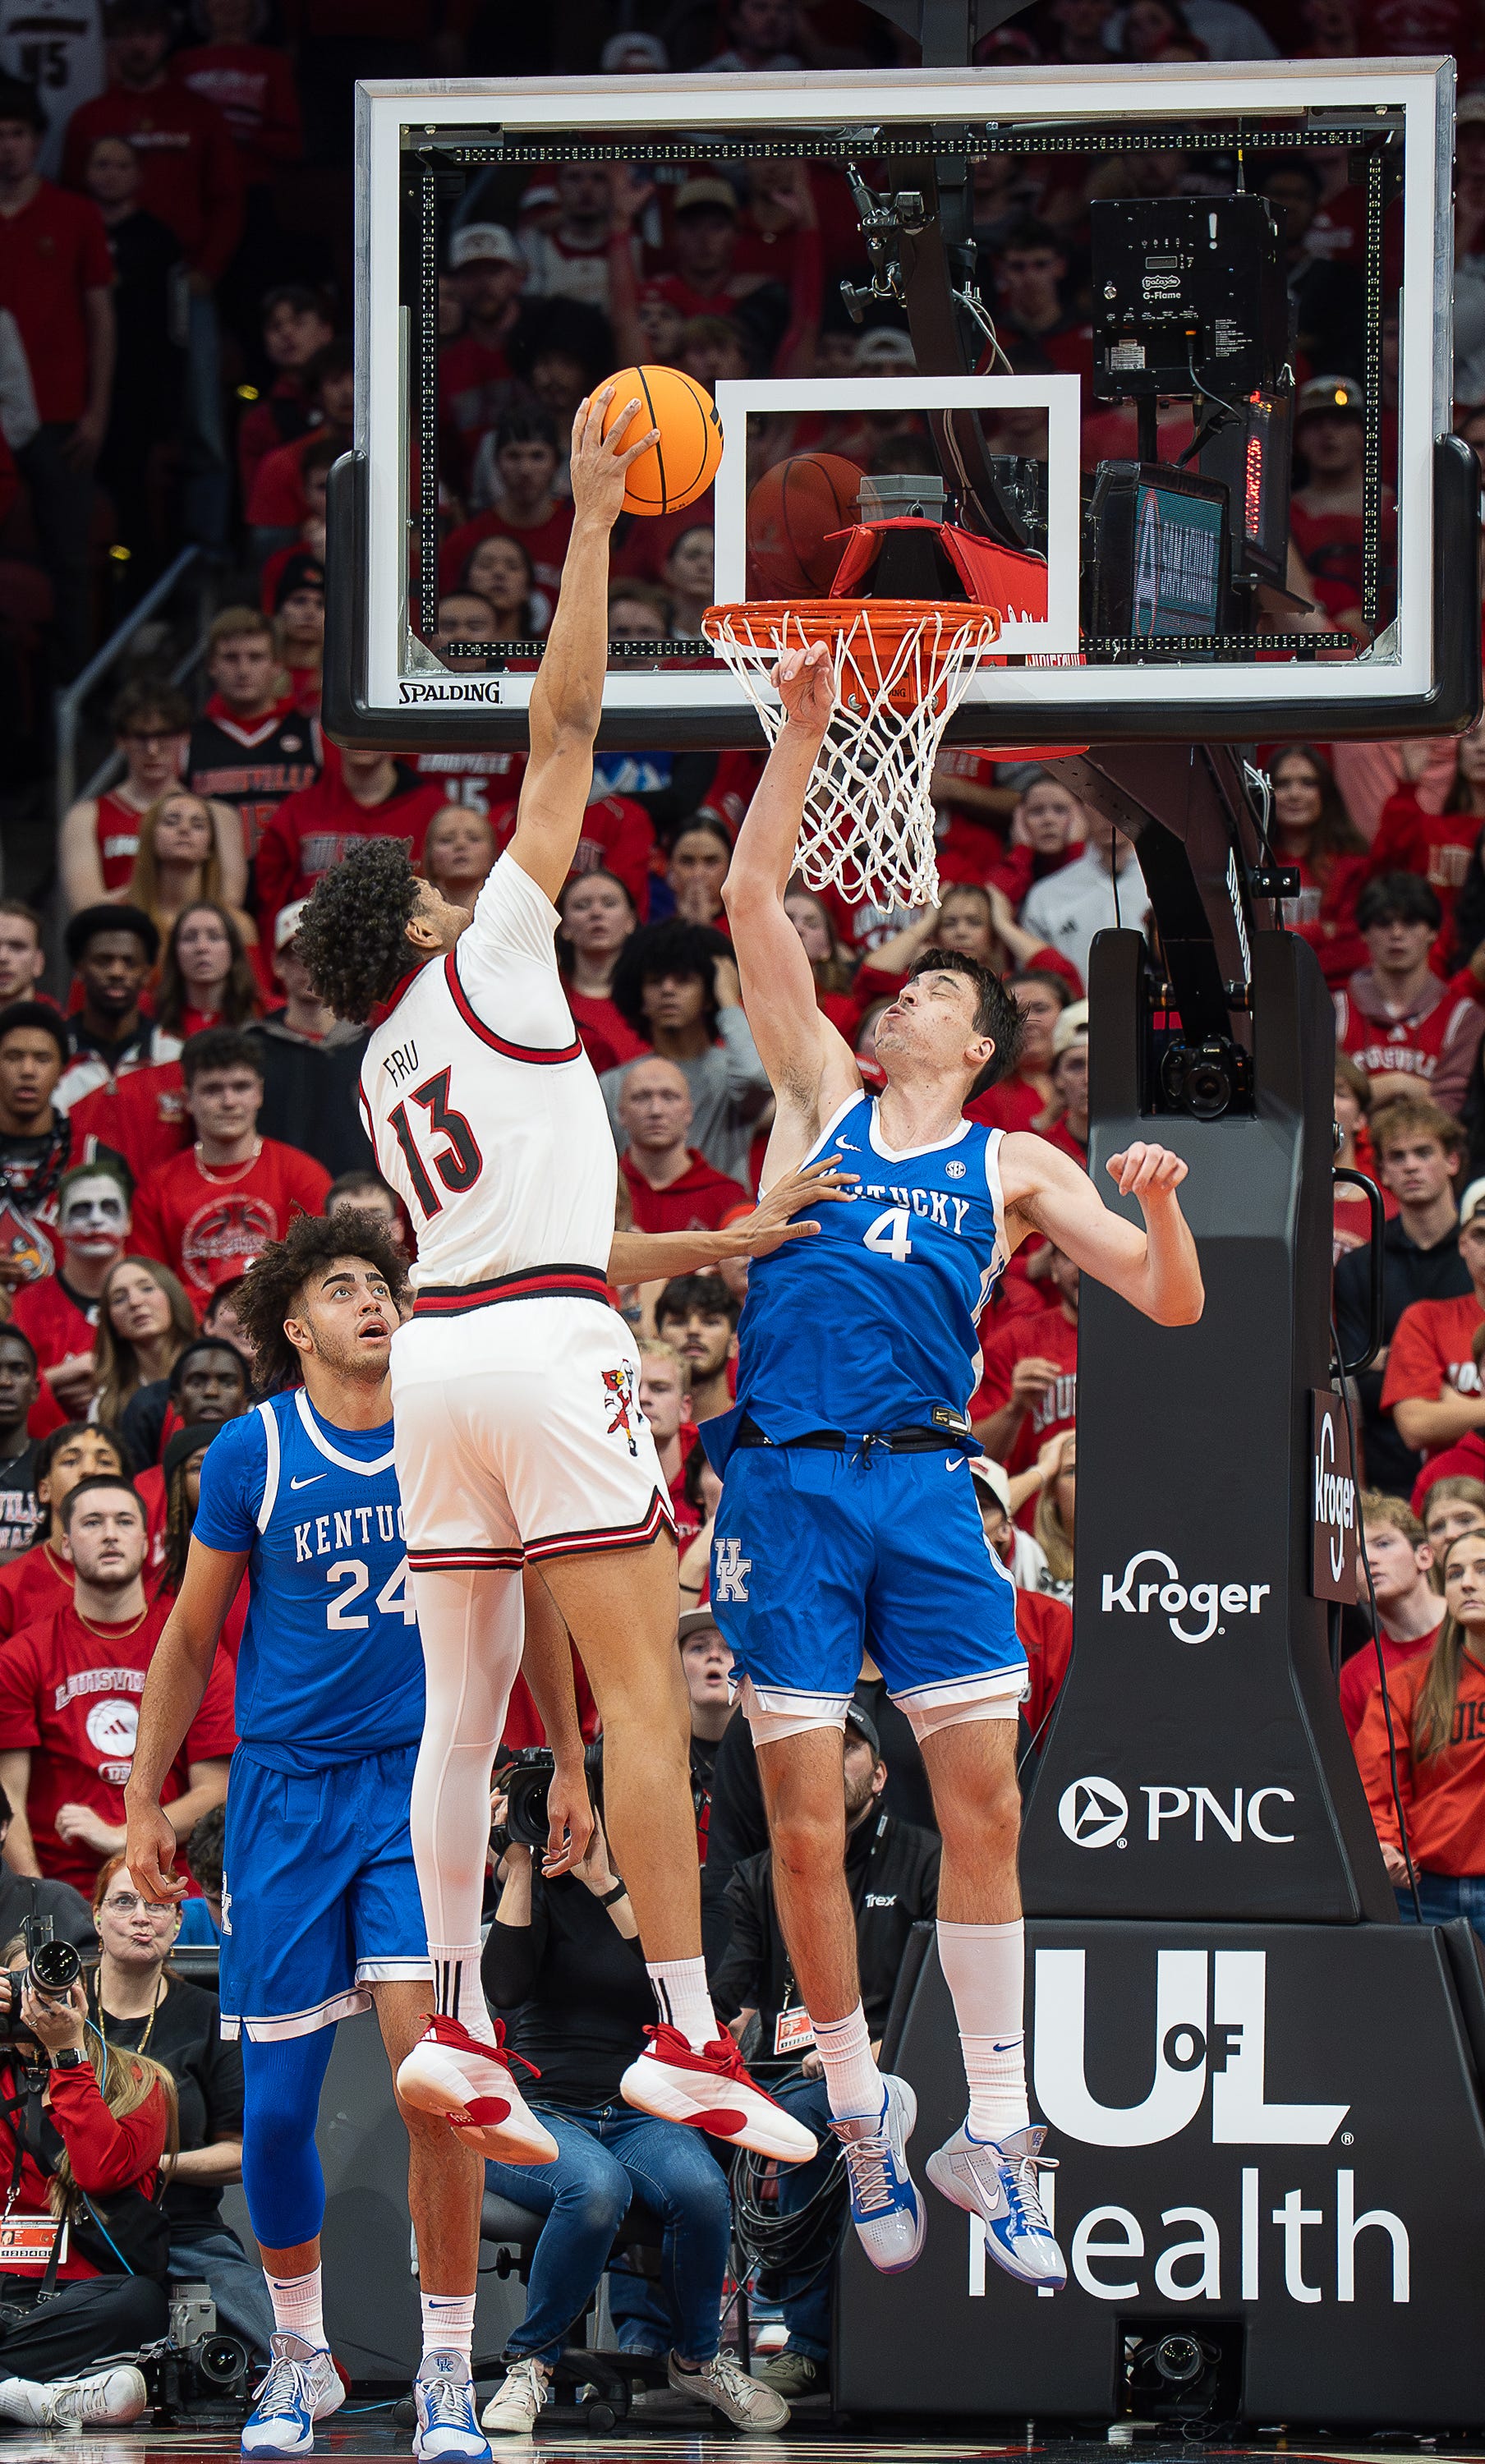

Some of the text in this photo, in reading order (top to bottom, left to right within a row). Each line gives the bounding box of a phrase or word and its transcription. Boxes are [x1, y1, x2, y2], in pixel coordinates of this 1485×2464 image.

[1142, 292, 1181, 300] G-Flame
[383, 1040, 419, 1087] FRU
[387, 1064, 483, 1221] 13
[947, 1161, 965, 1179] SEC
[863, 1207, 913, 1263] 4
[1315, 1413, 1355, 1583] Kroger
[327, 1555, 416, 1630] 24
[715, 1538, 752, 1602] UK
[1101, 1550, 1270, 1643] Kroger
[1139, 1786, 1295, 1843] PNC
[865, 1894, 897, 1908] Trex
